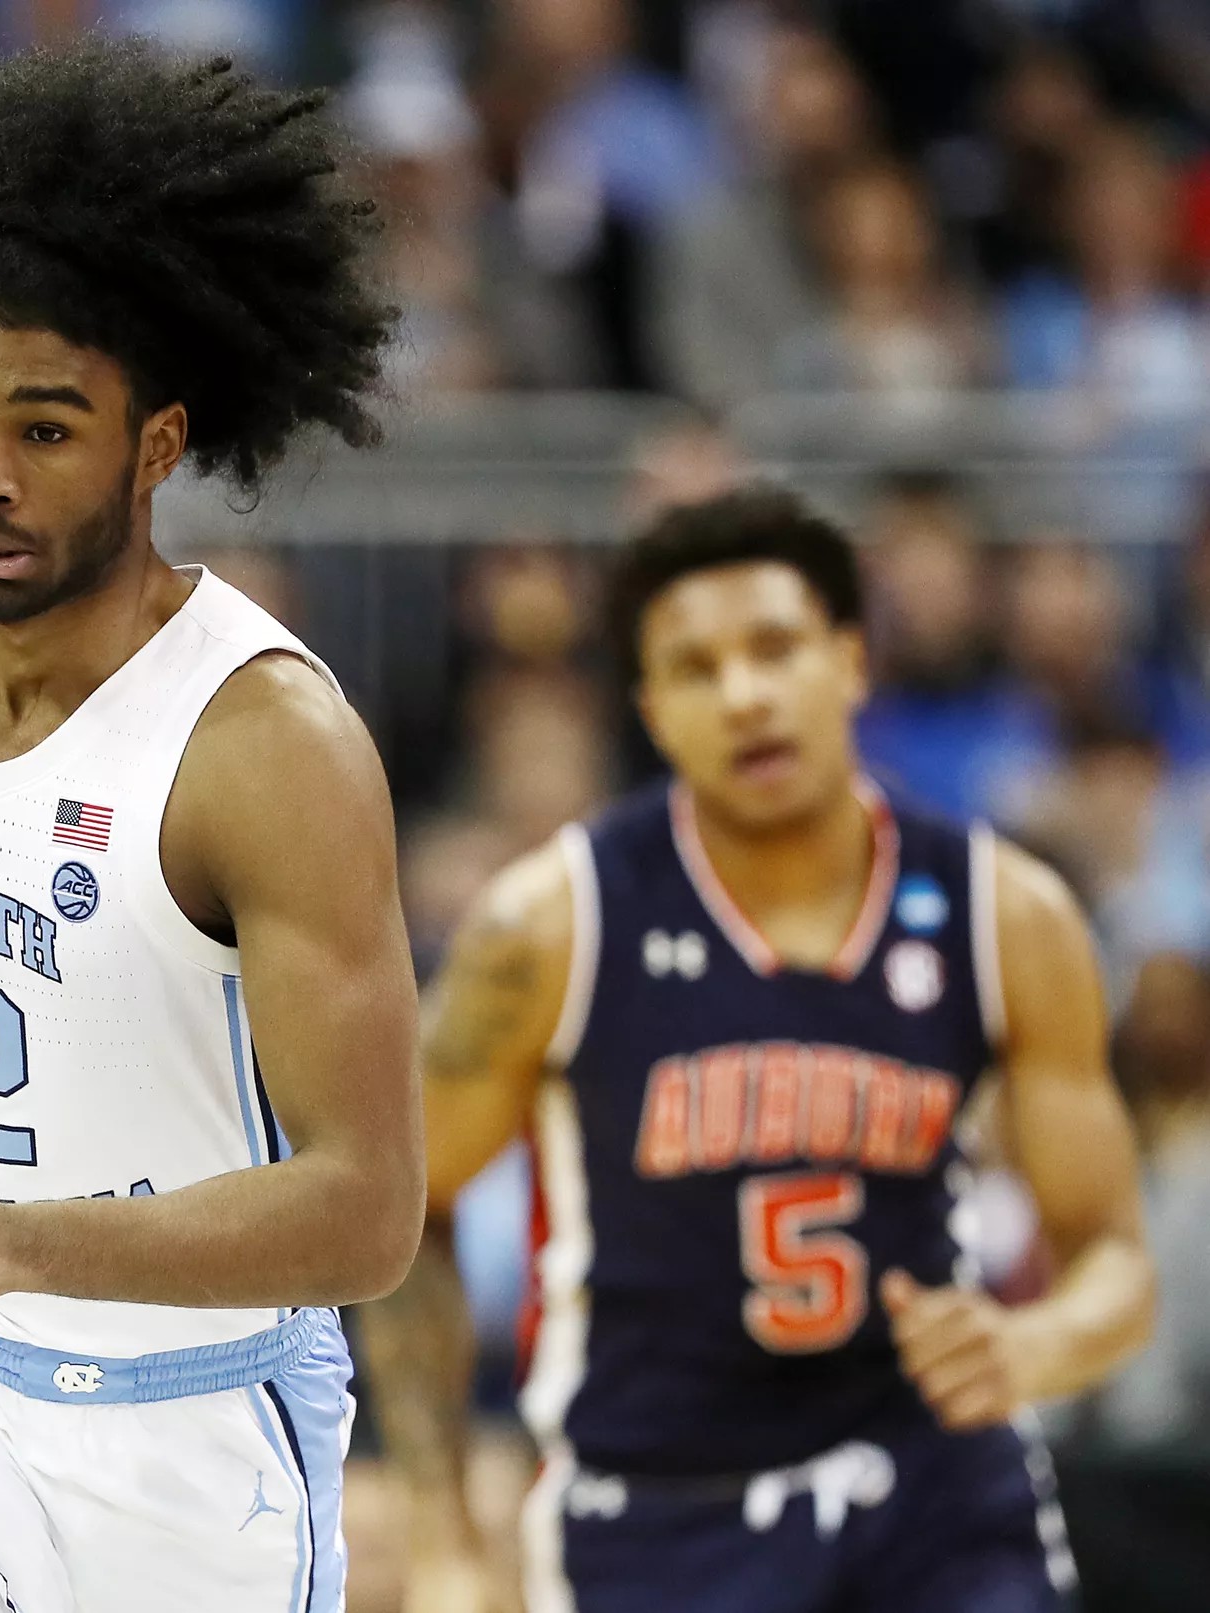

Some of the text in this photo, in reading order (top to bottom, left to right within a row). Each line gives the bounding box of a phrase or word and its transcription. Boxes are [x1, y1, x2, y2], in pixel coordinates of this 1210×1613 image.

[57, 880, 95, 898] ACC
[633, 1040, 962, 1180] AUBURN
[736, 1165, 869, 1356] 5
